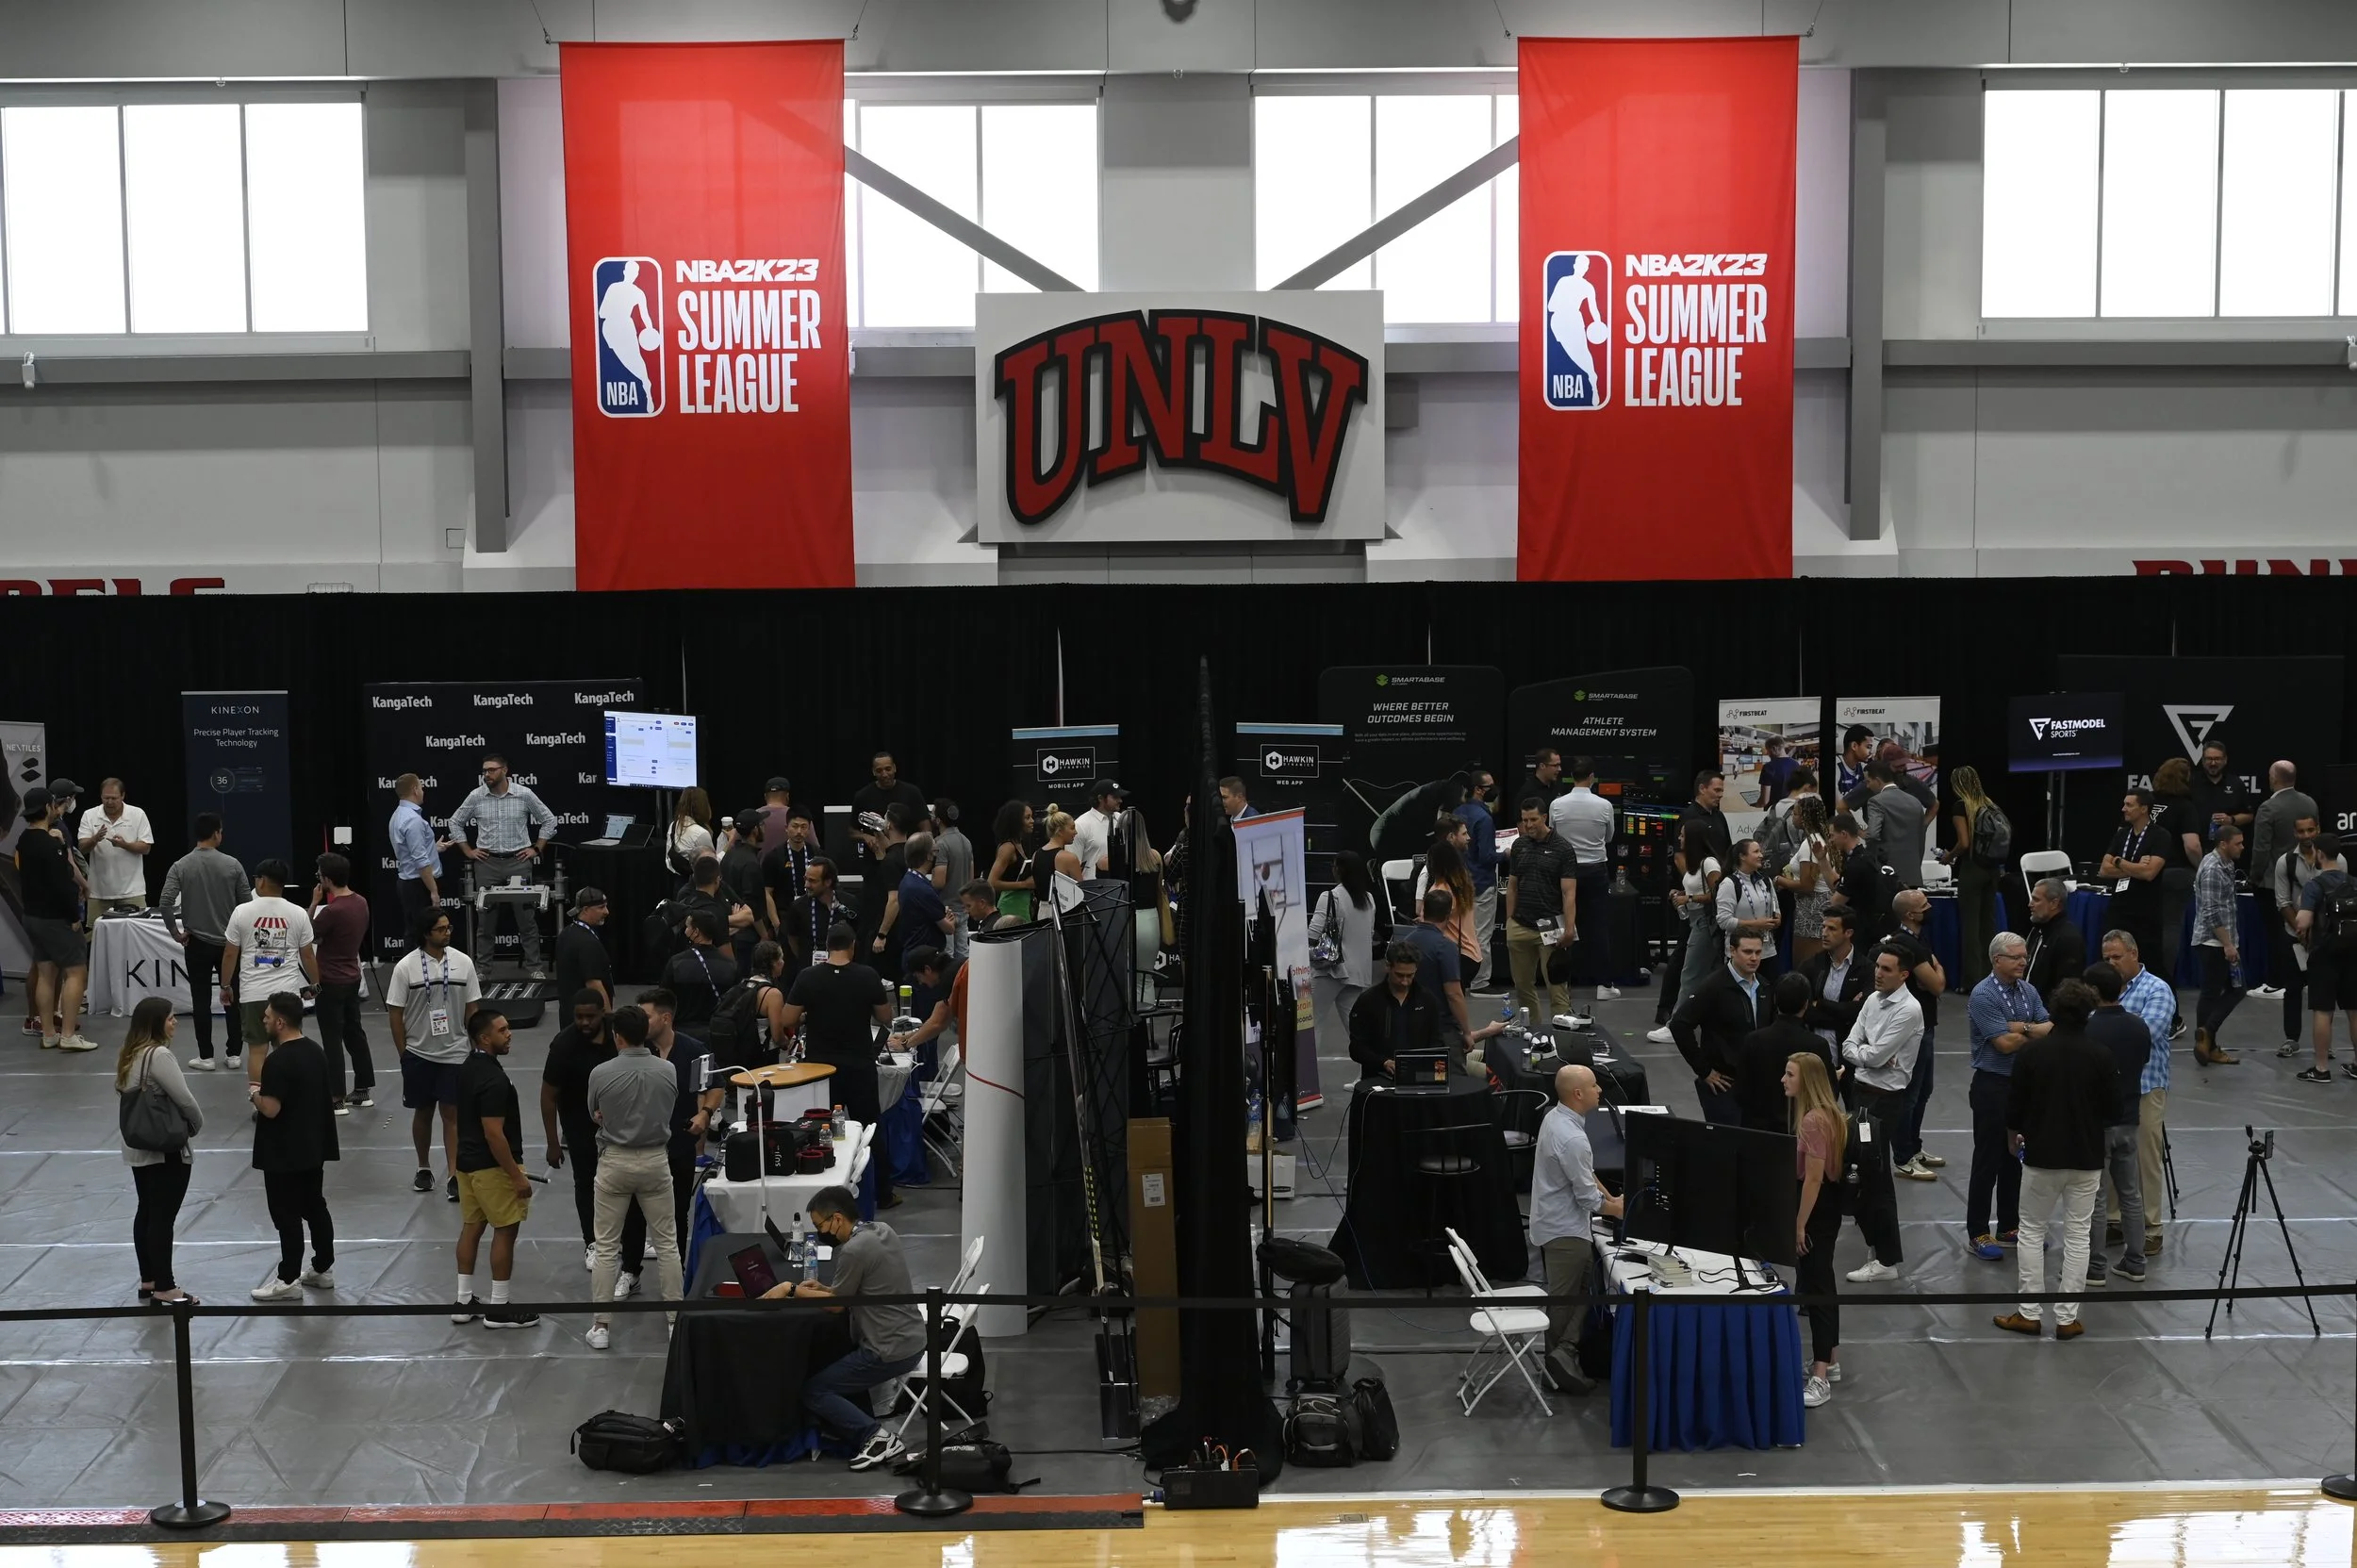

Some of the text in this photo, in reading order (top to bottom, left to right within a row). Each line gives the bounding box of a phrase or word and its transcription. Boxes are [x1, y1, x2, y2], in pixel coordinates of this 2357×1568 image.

[675, 258, 819, 283] NBA2K23
[1625, 253, 1768, 277] NBA2K23
[677, 289, 822, 351] SUMMER
[1624, 283, 1768, 344] SUMMER
[678, 353, 799, 414] LEAGUE
[1624, 346, 1743, 407] LEAGUE
[606, 381, 639, 406] NBA
[1553, 374, 1585, 399] NBA
[995, 308, 1369, 526] UNLV
[372, 696, 433, 711] KangaTech
[473, 693, 534, 708] KangaTech
[575, 690, 635, 706] KangaTech
[211, 705, 259, 715] KINEXON
[1373, 701, 1449, 712] WHERE BETTER
[1367, 714, 1455, 724] OUTCOMES BEGIN
[1582, 717, 1624, 725] ATHLETE
[2051, 718, 2106, 731] FASTMODEL
[193, 727, 279, 738] Precise Player Tracking
[1550, 727, 1657, 736] MANAGEMENT SYSTEM
[2050, 730, 2079, 739] SPORTS
[215, 735, 258, 748] Technology
[425, 734, 486, 751] KangaTech
[526, 732, 586, 747] KangaTech
[1059, 757, 1090, 767] HAWKIN
[1283, 755, 1314, 764] HAWKIN
[217, 776, 228, 784] 36
